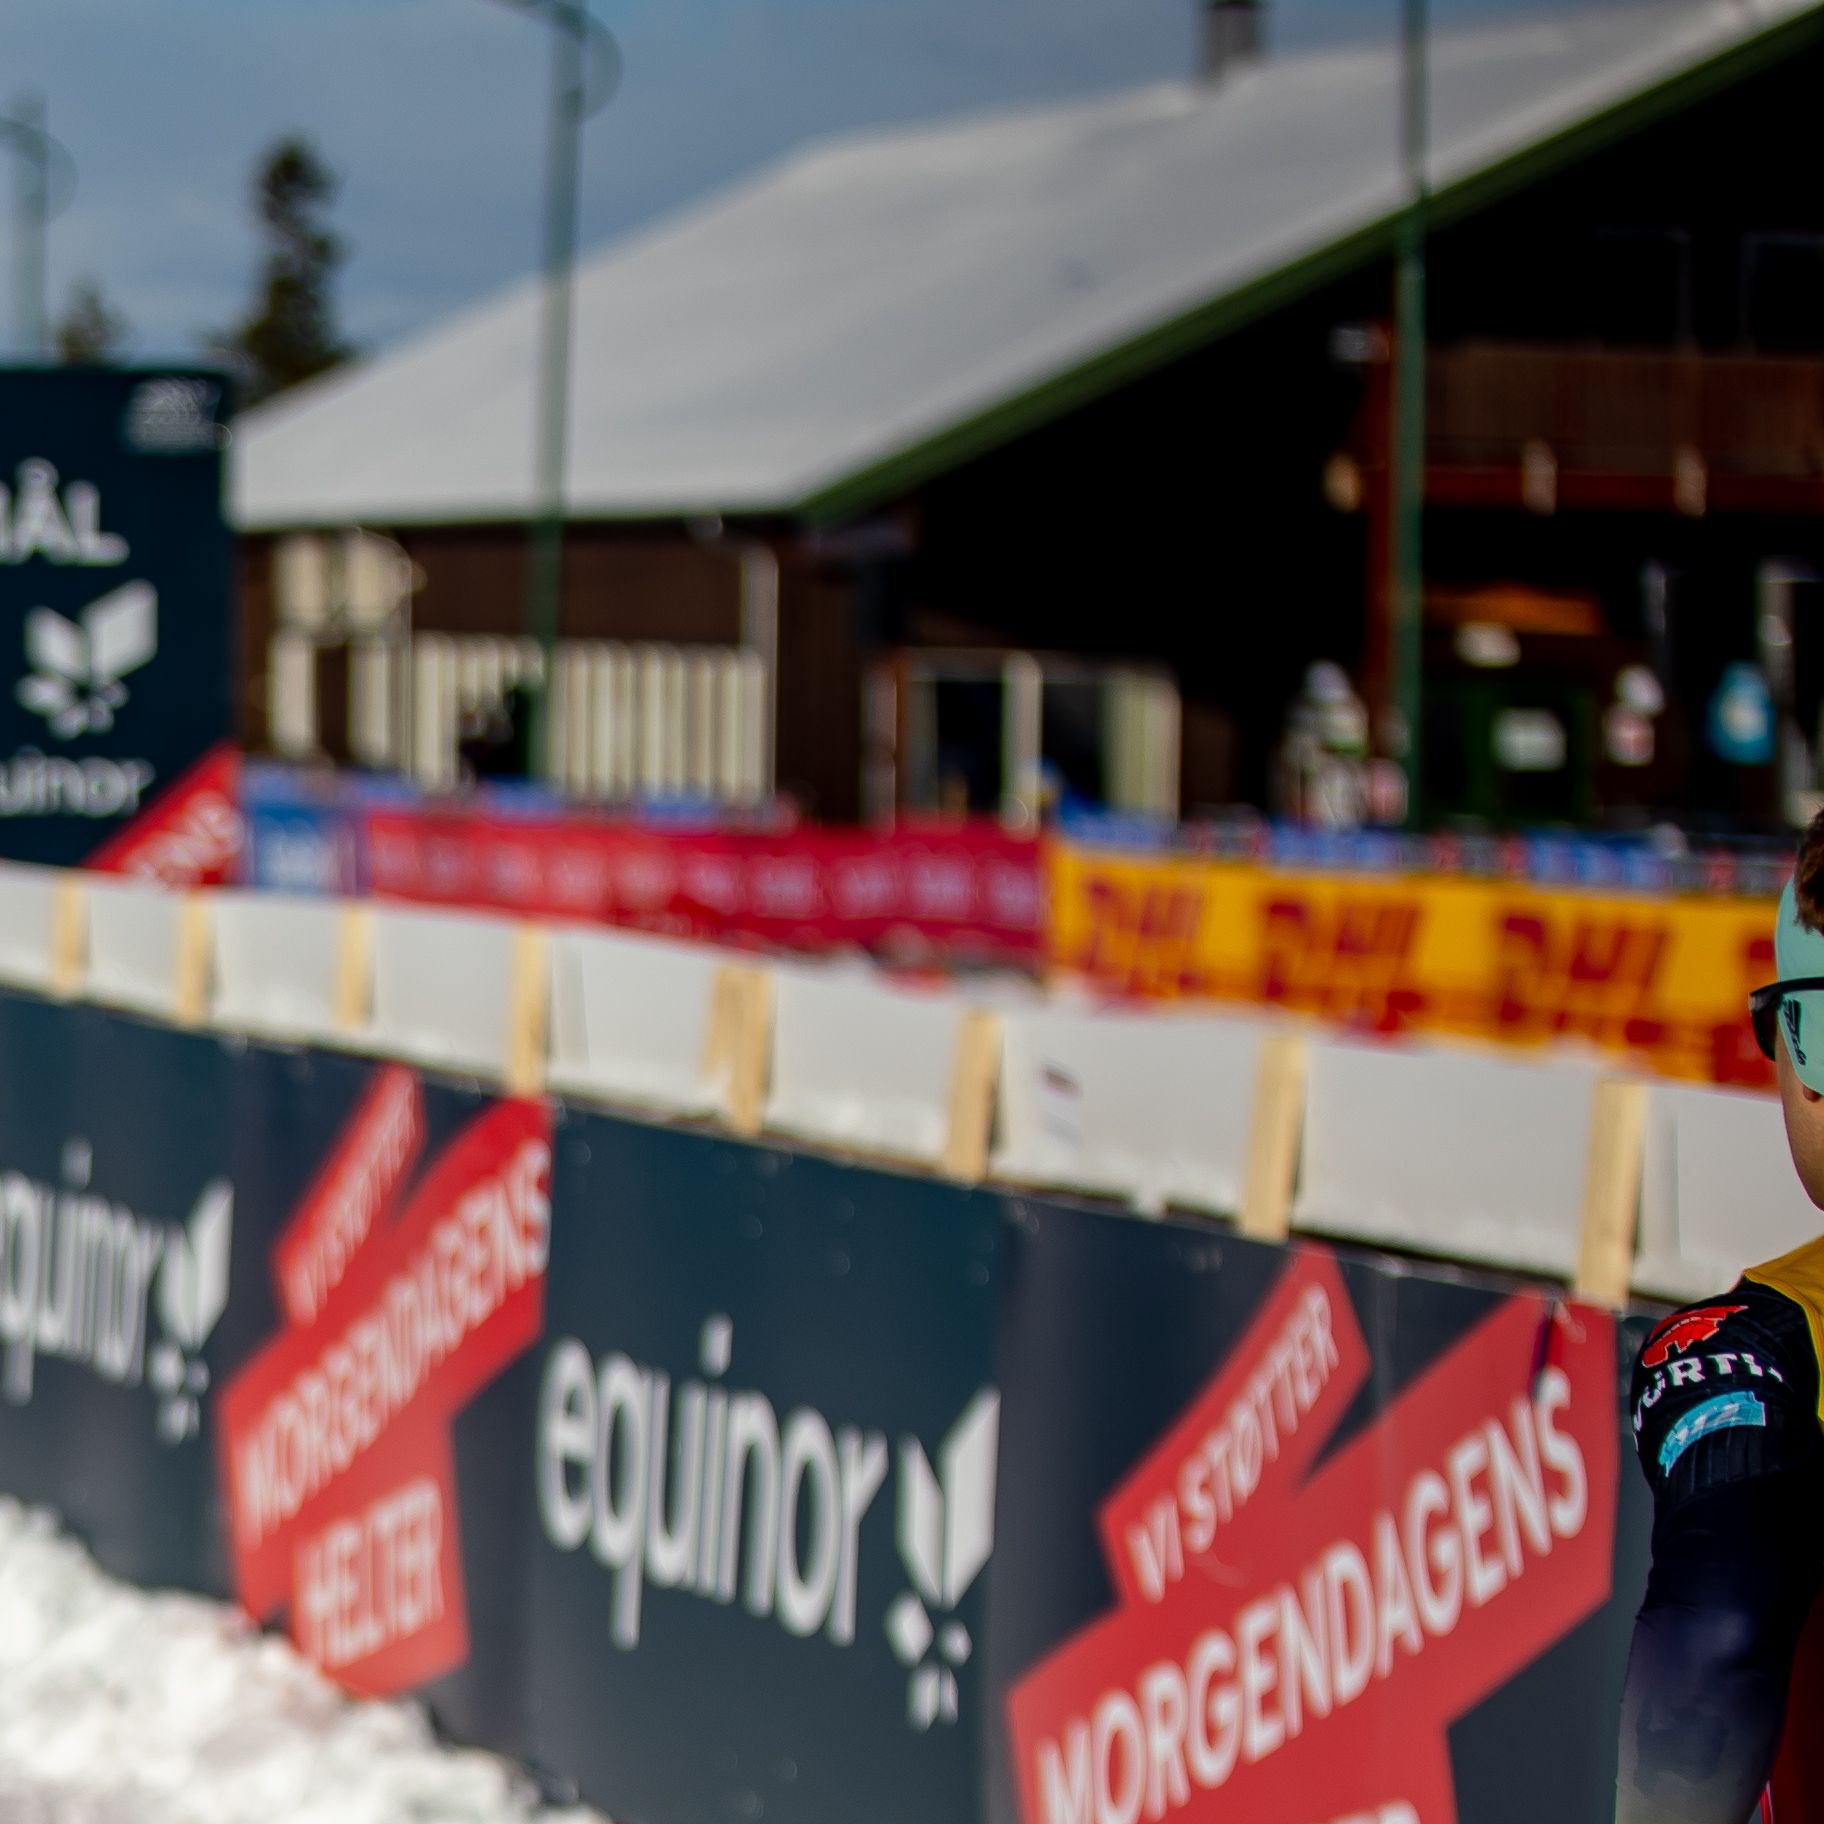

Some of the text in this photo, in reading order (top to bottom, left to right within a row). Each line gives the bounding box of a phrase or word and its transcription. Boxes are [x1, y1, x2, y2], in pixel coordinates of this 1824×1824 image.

[236, 1140, 552, 1552] MORGENDAGENS
[535, 1312, 889, 1653] equinor
[1125, 1281, 1342, 1602] VI STØTTER
